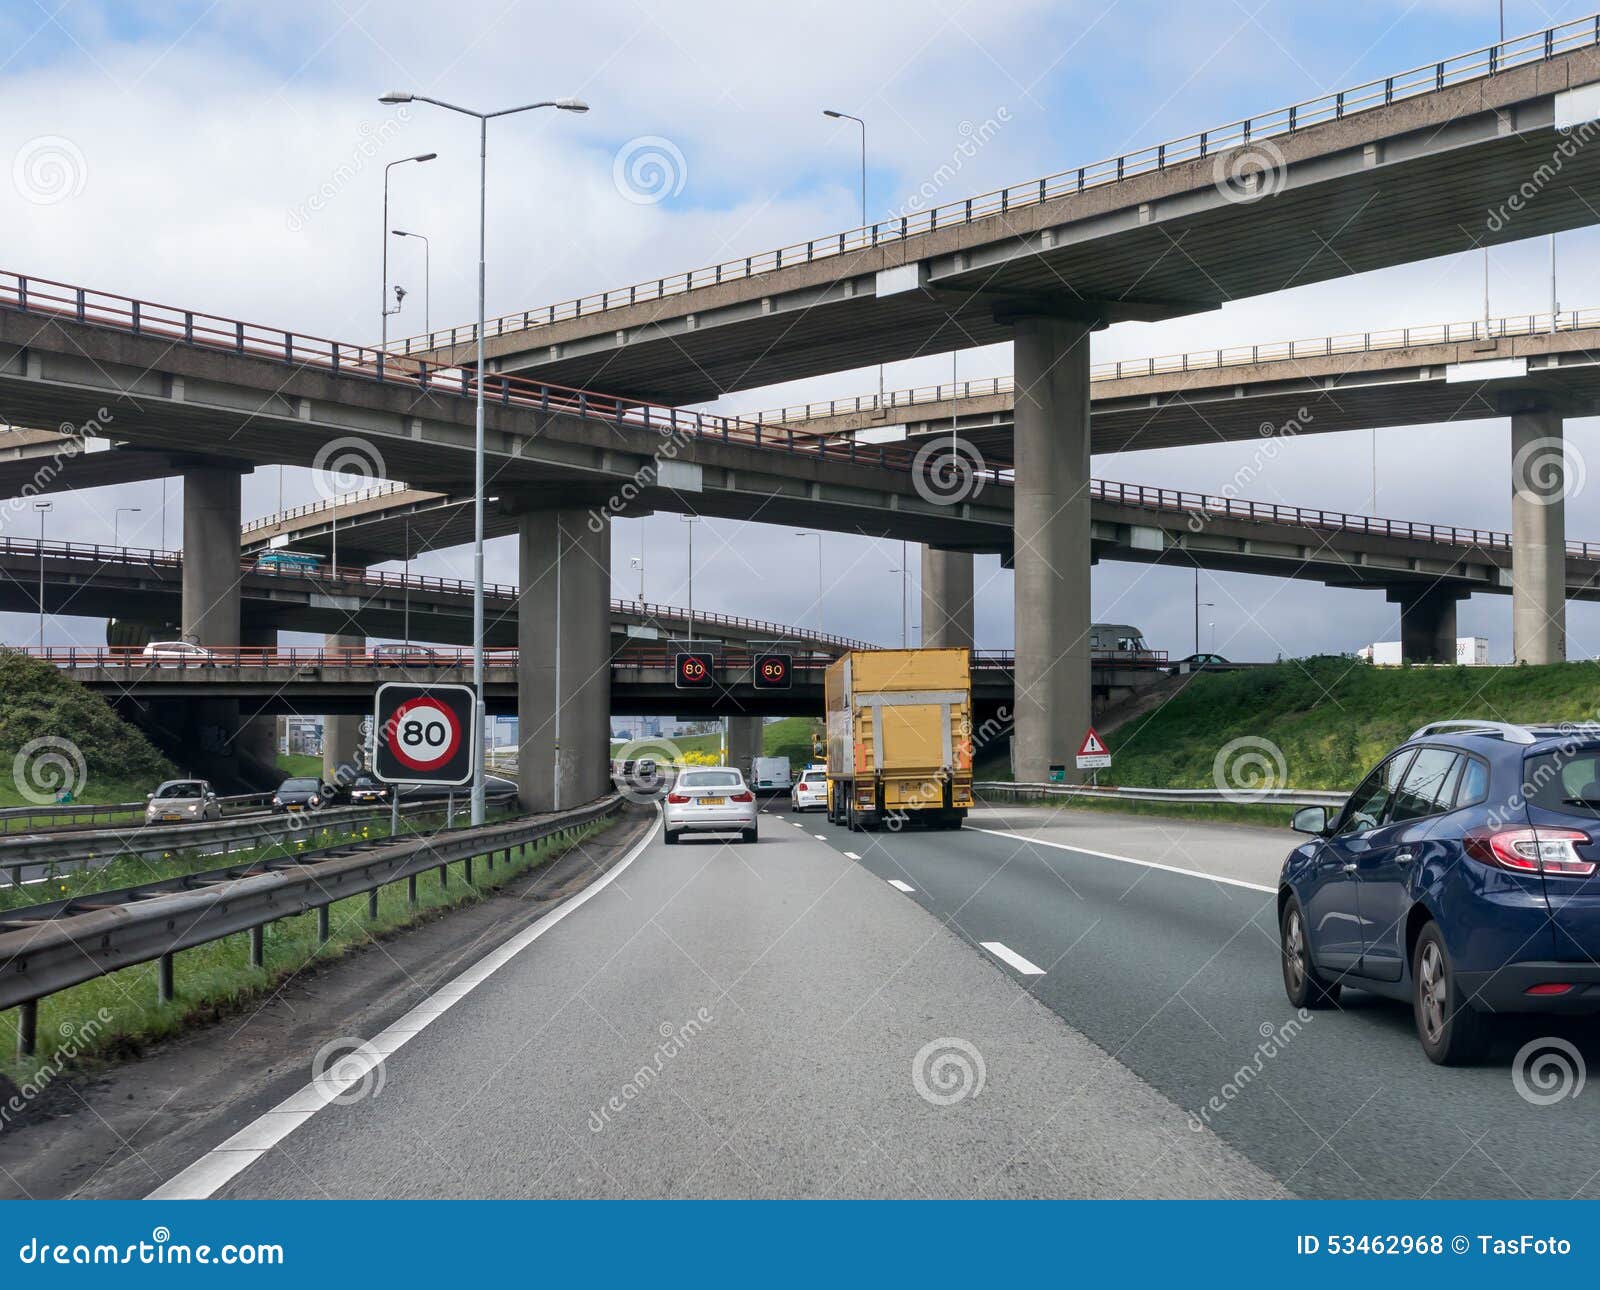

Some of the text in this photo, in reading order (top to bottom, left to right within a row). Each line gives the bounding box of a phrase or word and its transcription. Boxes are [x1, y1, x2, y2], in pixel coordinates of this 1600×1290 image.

[685, 664, 703, 675] 80
[764, 664, 782, 675] 80
[403, 720, 446, 747] 80
